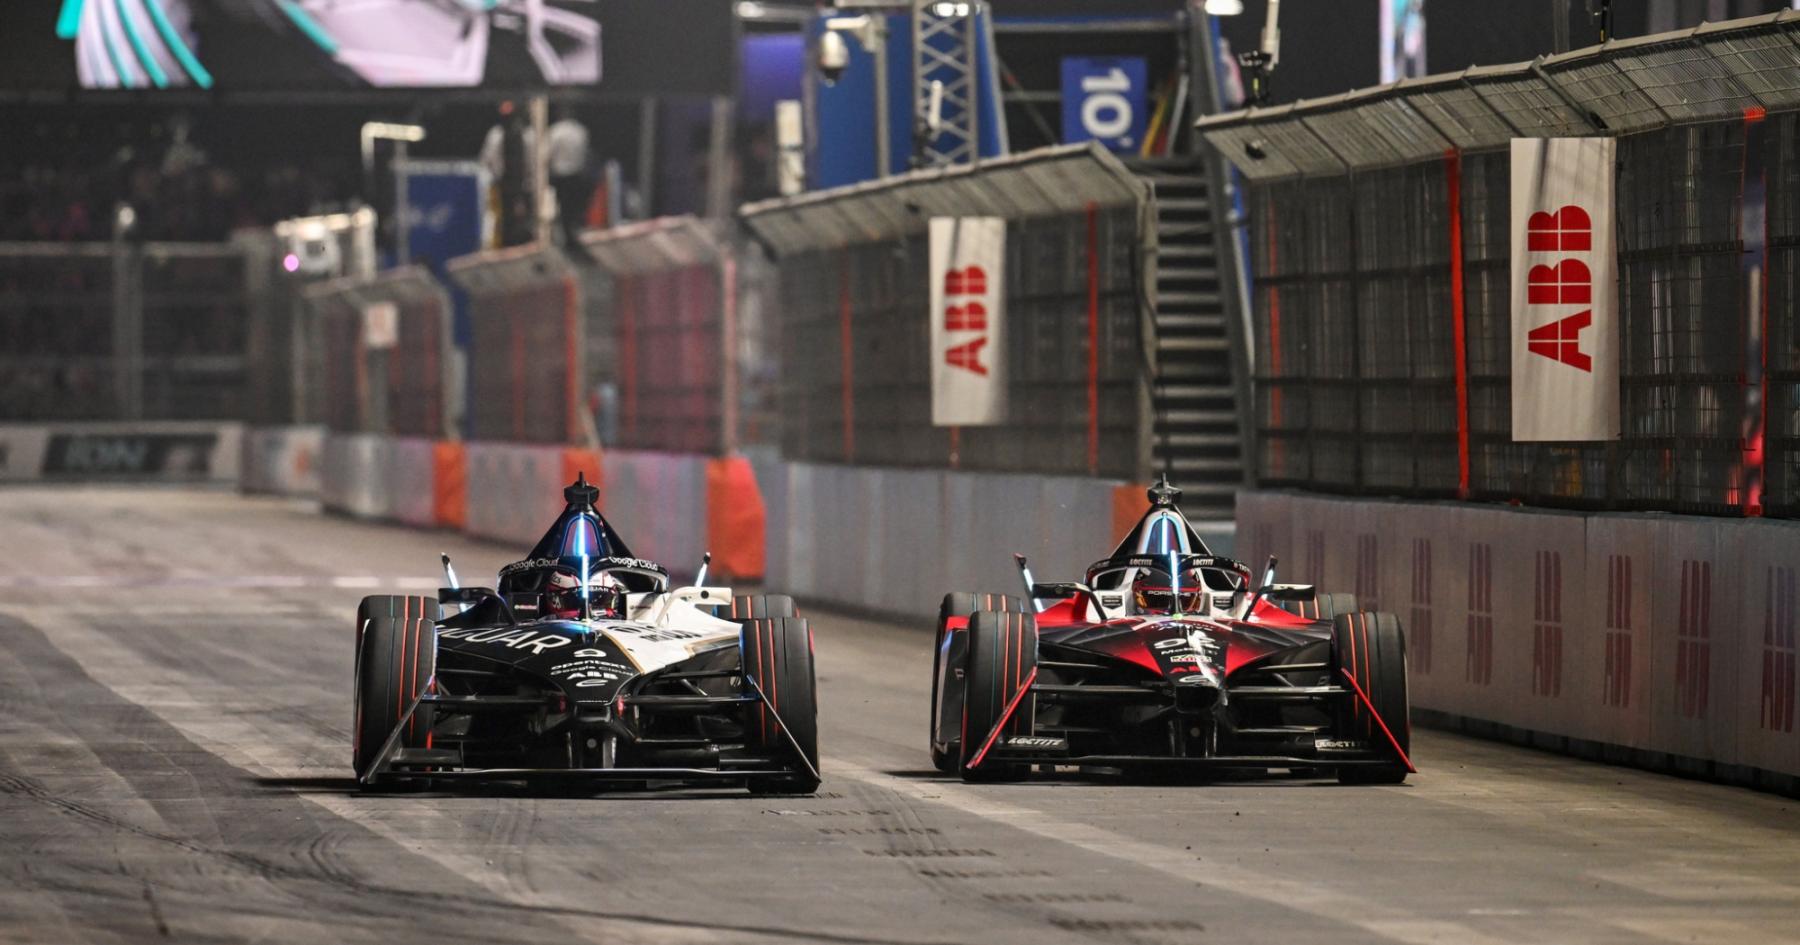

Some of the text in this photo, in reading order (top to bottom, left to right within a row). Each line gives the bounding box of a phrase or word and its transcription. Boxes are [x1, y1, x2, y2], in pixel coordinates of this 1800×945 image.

[1528, 205, 1592, 373] ABB
[944, 265, 988, 376] ABB
[1130, 558, 1153, 566] LOCTITE
[437, 627, 572, 655] AGUAR
[573, 648, 607, 657] 9
[566, 671, 619, 680] ABB
[1008, 737, 1064, 746] LOCTITE
[1320, 740, 1364, 748] LOCTI
